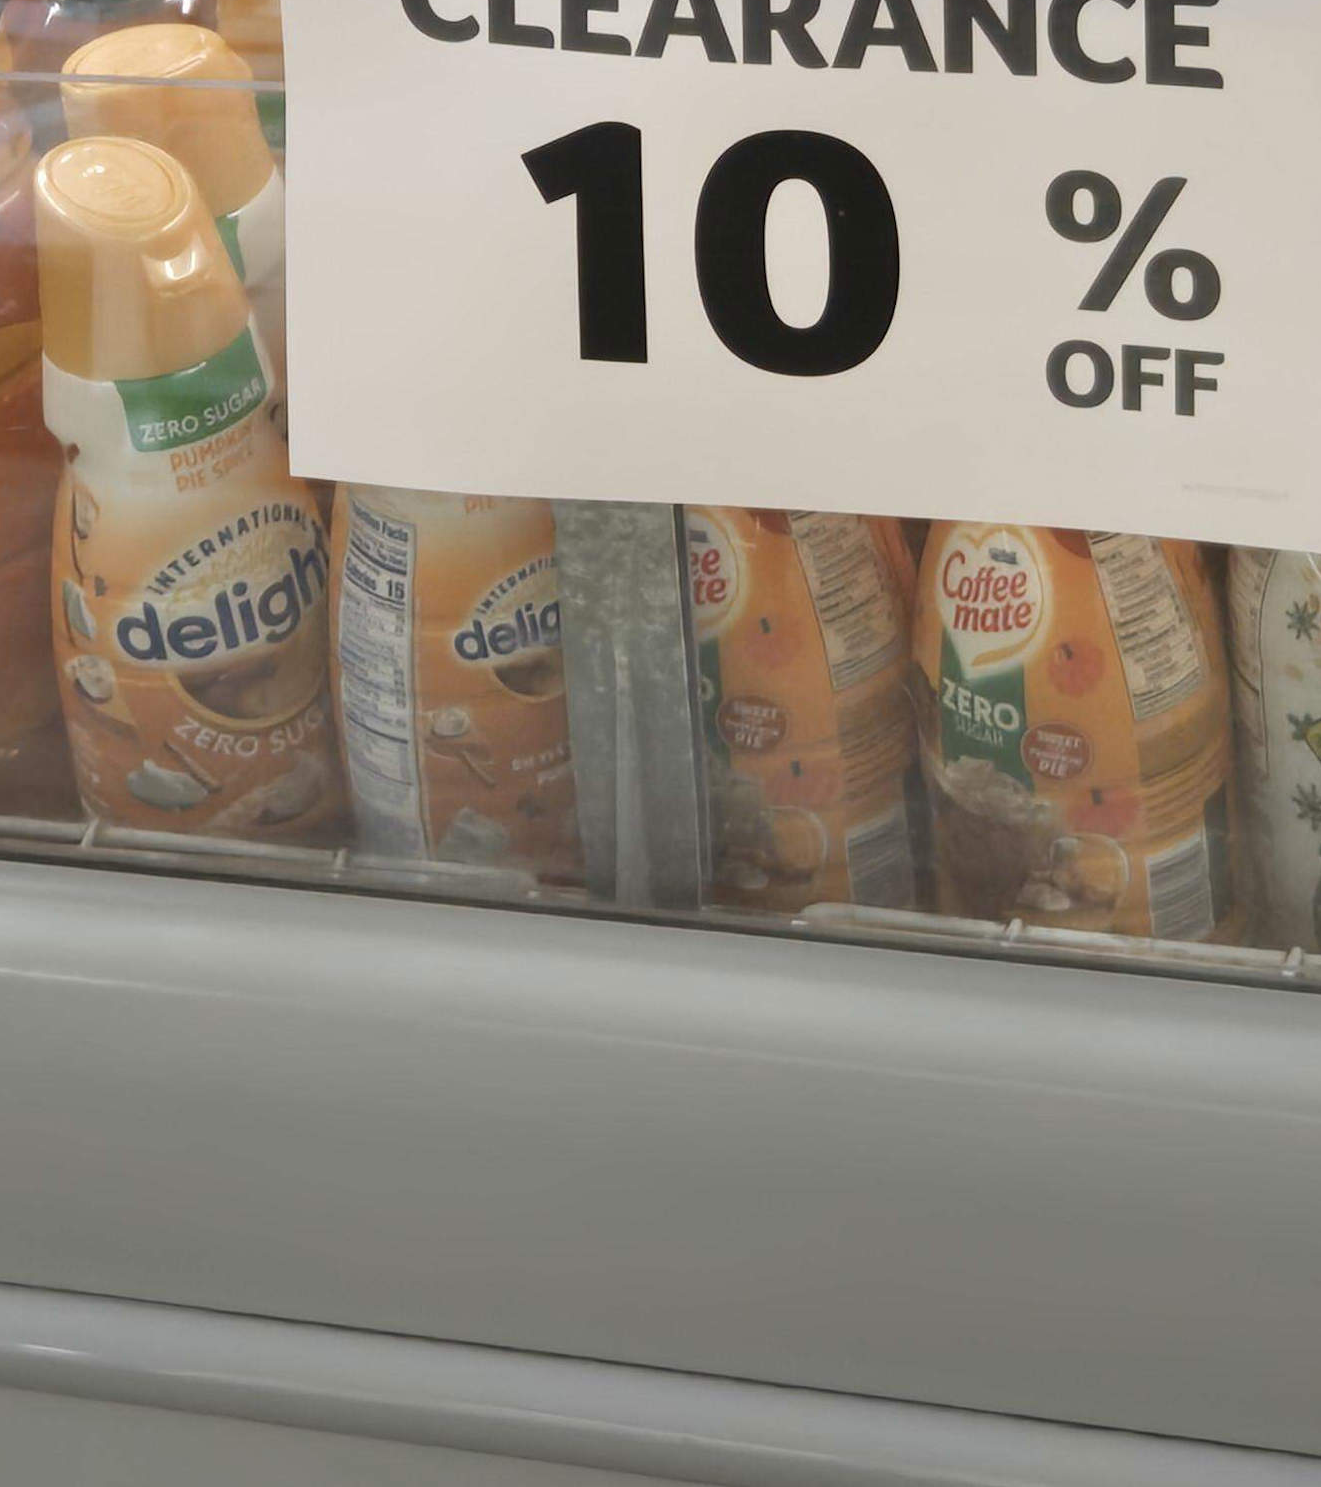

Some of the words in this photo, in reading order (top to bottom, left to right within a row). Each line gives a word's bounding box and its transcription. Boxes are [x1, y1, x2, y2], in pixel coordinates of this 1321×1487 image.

[520, 120, 900, 377] 10
[1044, 169, 1221, 321] %
[1045, 339, 1225, 416] OFF
[138, 415, 201, 445] ZERO
[202, 376, 263, 428] SUGAR
[146, 501, 312, 597] INTERNATIONAL
[941, 549, 1028, 604] Coffee
[453, 600, 561, 663] delig
[953, 601, 1033, 634] mate
[940, 676, 1021, 731] ZERO
[174, 714, 261, 759] ZERO
